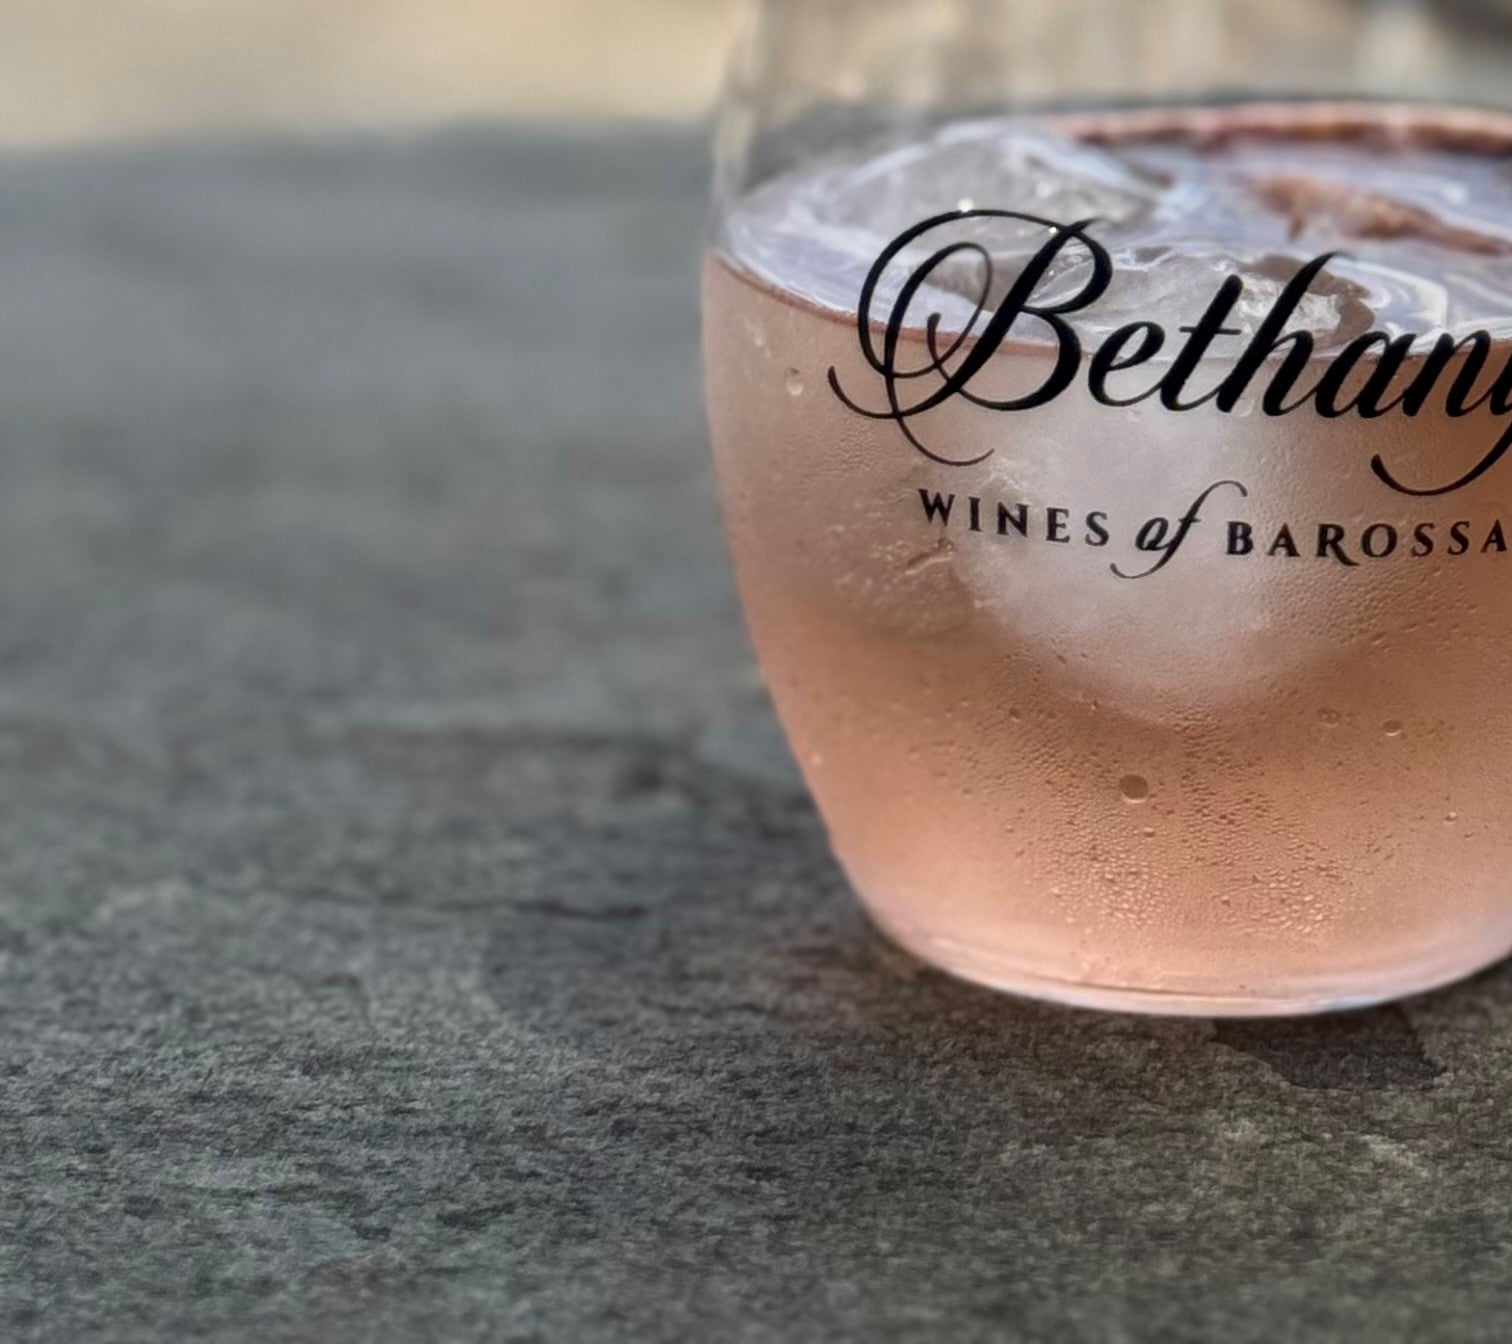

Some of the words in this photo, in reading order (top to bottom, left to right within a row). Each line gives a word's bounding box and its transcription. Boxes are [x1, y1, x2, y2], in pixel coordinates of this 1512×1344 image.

[918, 488, 1111, 548] WINES
[1109, 480, 1248, 580] of
[1227, 519, 1509, 566] BAROSSA
